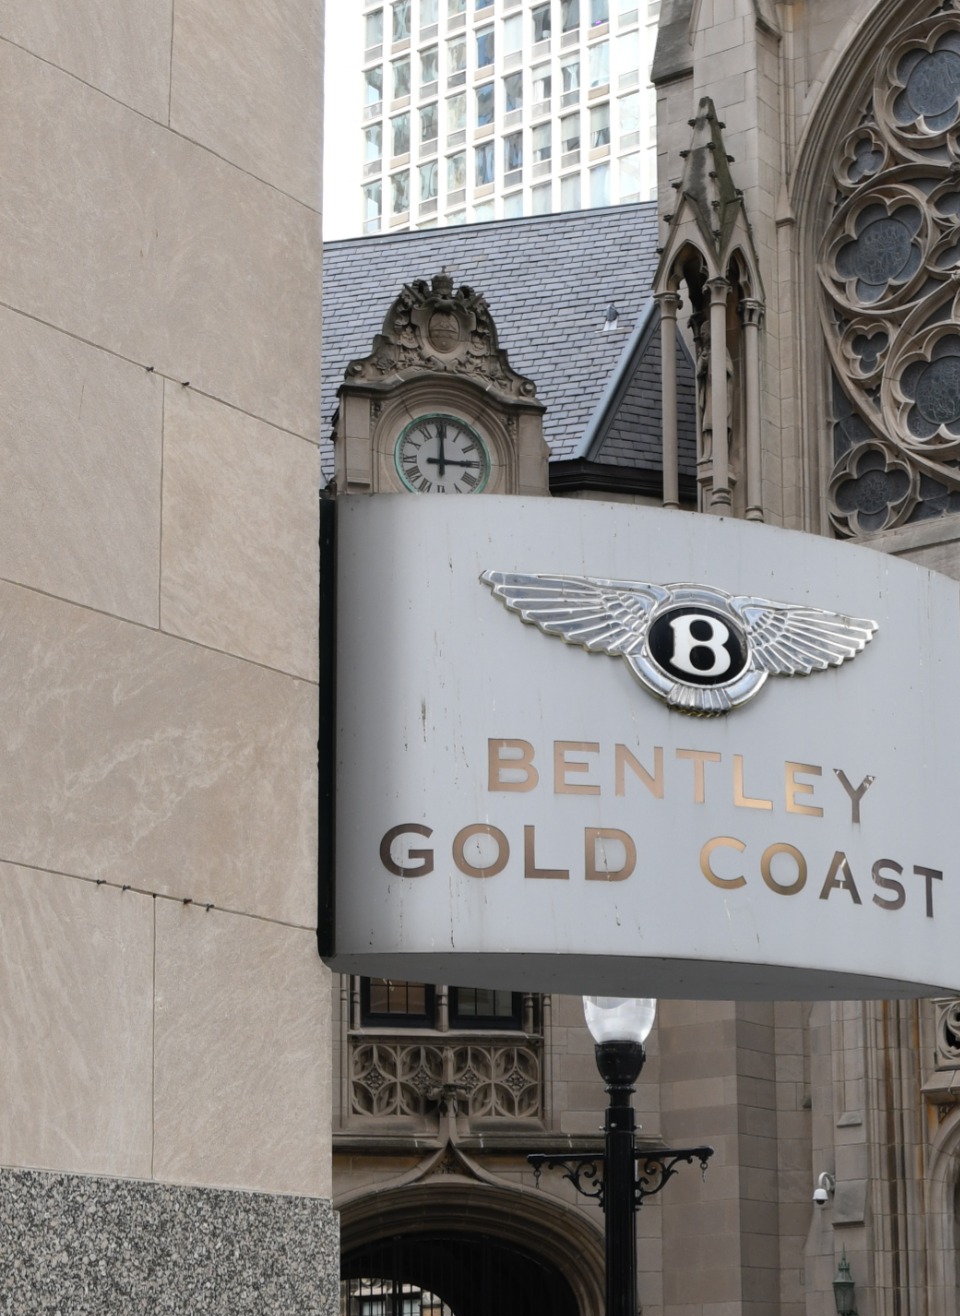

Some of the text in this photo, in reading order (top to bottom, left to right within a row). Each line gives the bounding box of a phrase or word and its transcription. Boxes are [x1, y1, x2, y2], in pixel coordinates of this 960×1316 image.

[417, 426, 432, 441] XI
[435, 424, 447, 439] XI
[407, 440, 421, 450] X
[461, 444, 475, 454] II
[403, 454, 417, 464] IX
[406, 465, 423, 484] VIII
[671, 613, 731, 677] B
[487, 738, 877, 825] BENTLEY
[379, 823, 944, 919] GOLD COAST
